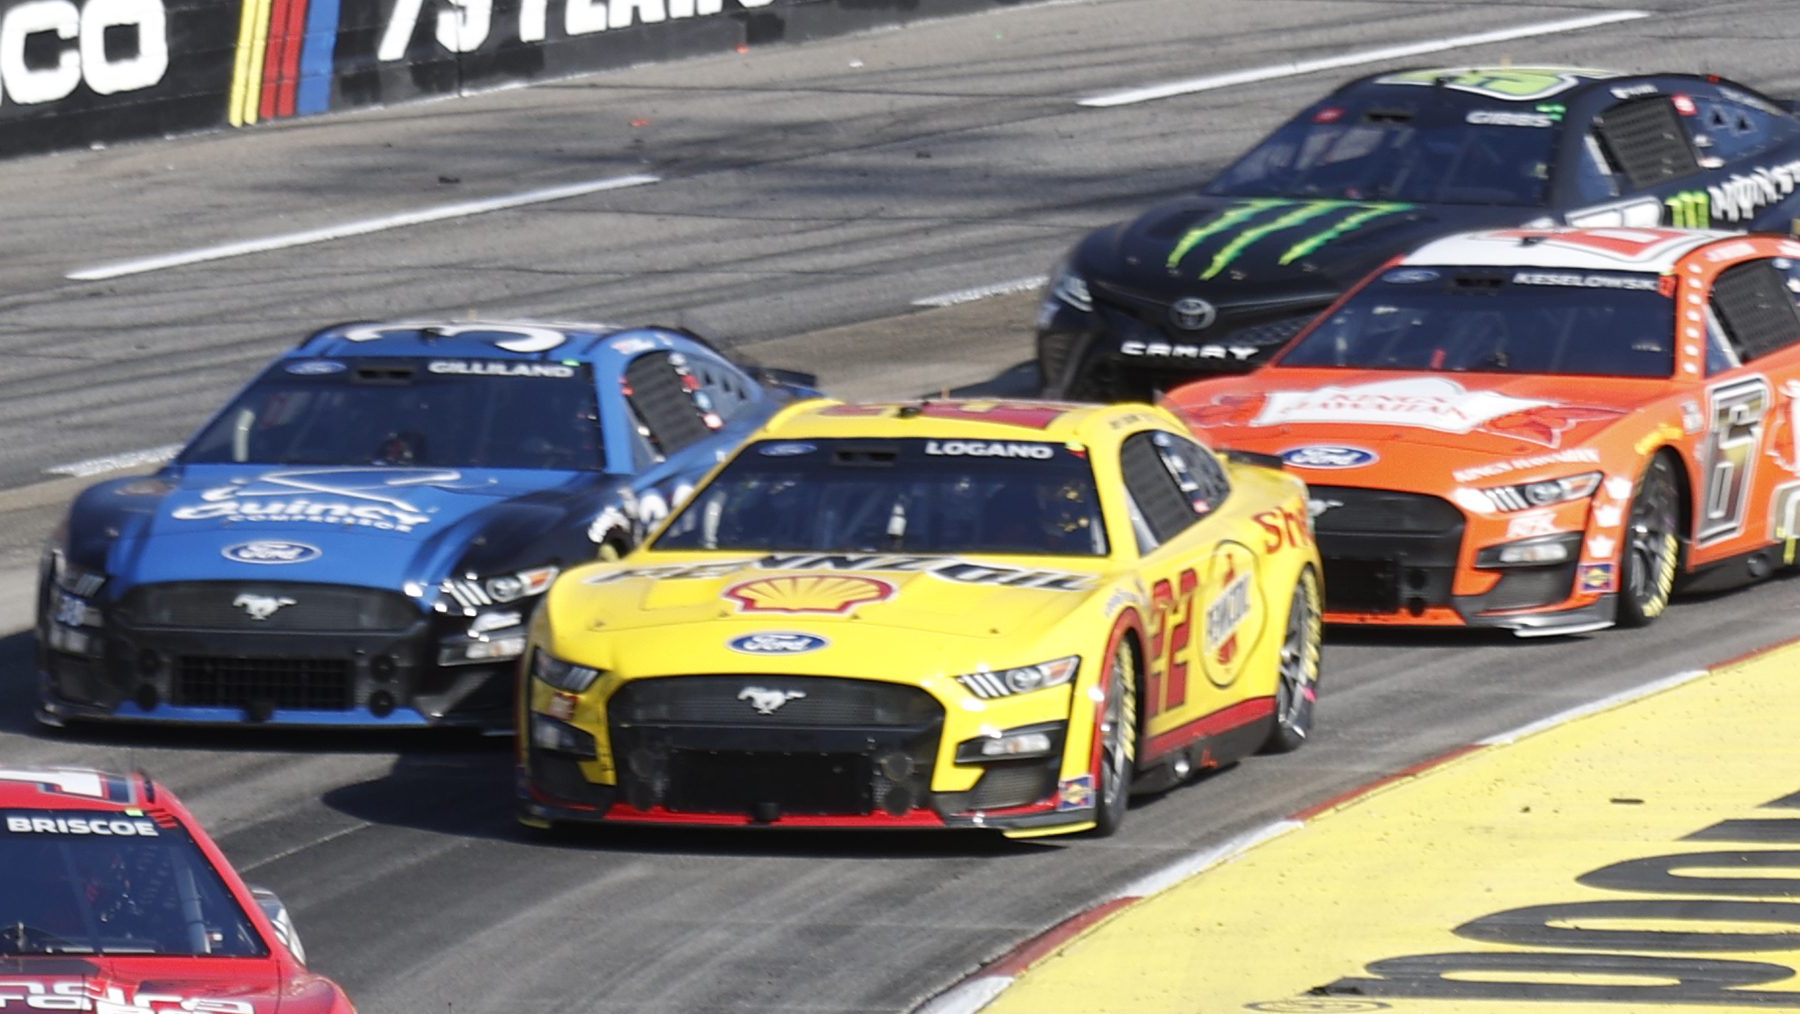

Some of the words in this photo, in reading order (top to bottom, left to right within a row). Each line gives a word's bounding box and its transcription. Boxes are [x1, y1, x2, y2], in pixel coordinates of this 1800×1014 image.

[1466, 110, 1553, 128] GIBBS
[428, 361, 575, 378] GILLILAND
[924, 440, 1054, 460] LOGANO
[7, 815, 159, 838] BRISCOE
